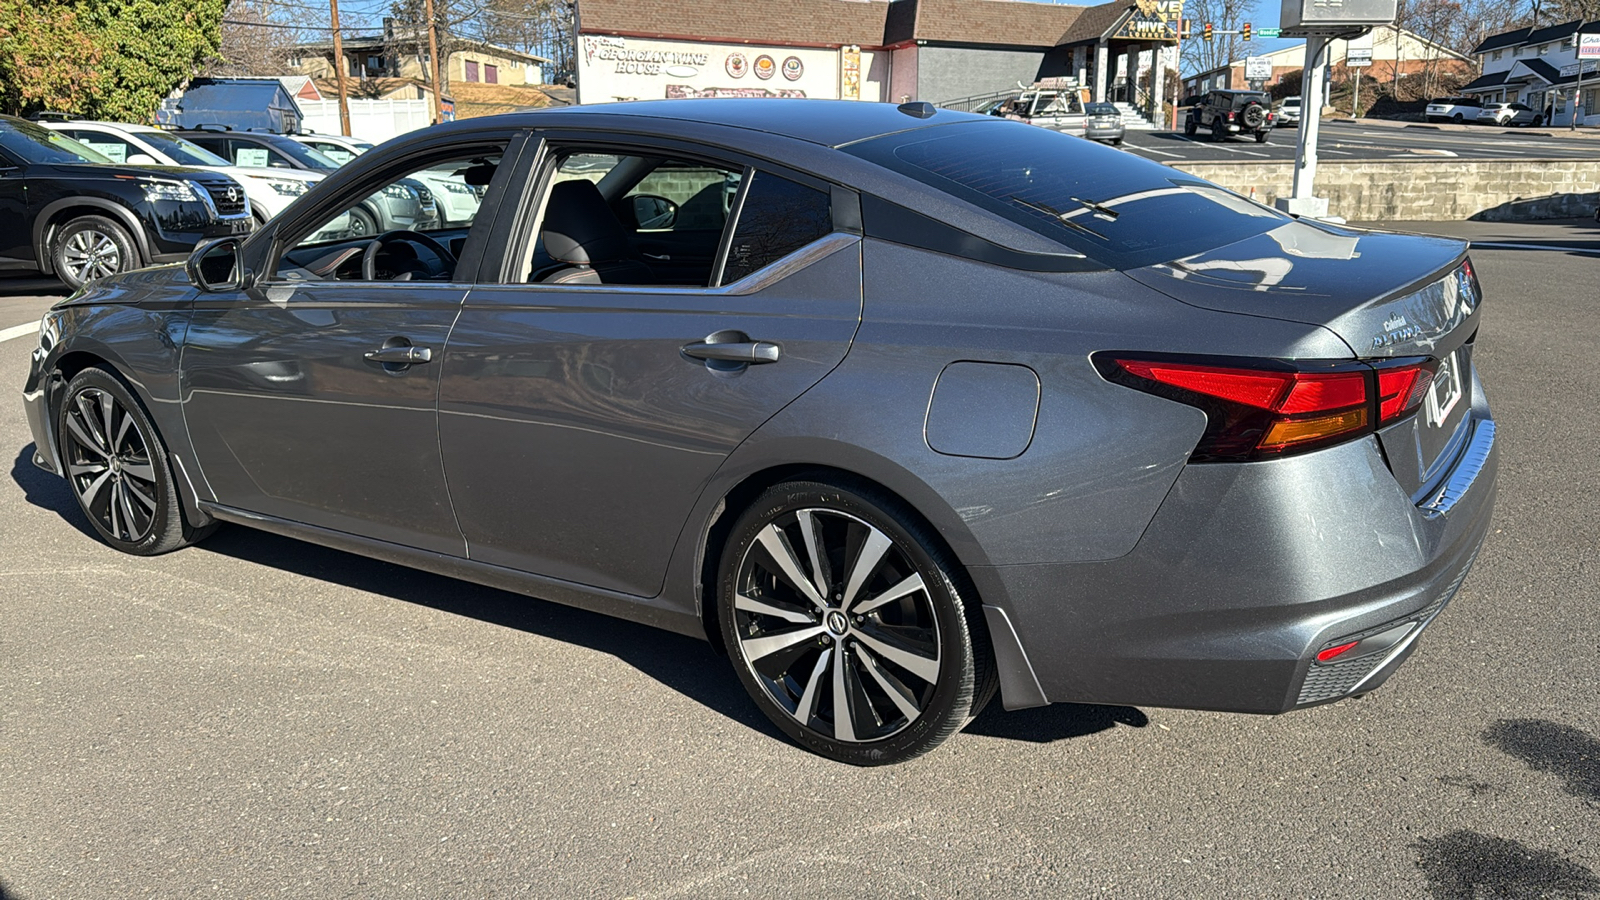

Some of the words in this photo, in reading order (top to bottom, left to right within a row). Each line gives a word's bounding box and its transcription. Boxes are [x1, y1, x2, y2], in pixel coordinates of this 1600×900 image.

[1137, 21, 1166, 33] HIVE
[599, 48, 669, 64] GEORGIAN
[670, 52, 709, 66] WINE
[614, 62, 661, 76] HOUSE
[1371, 325, 1422, 350] ALTIMA
